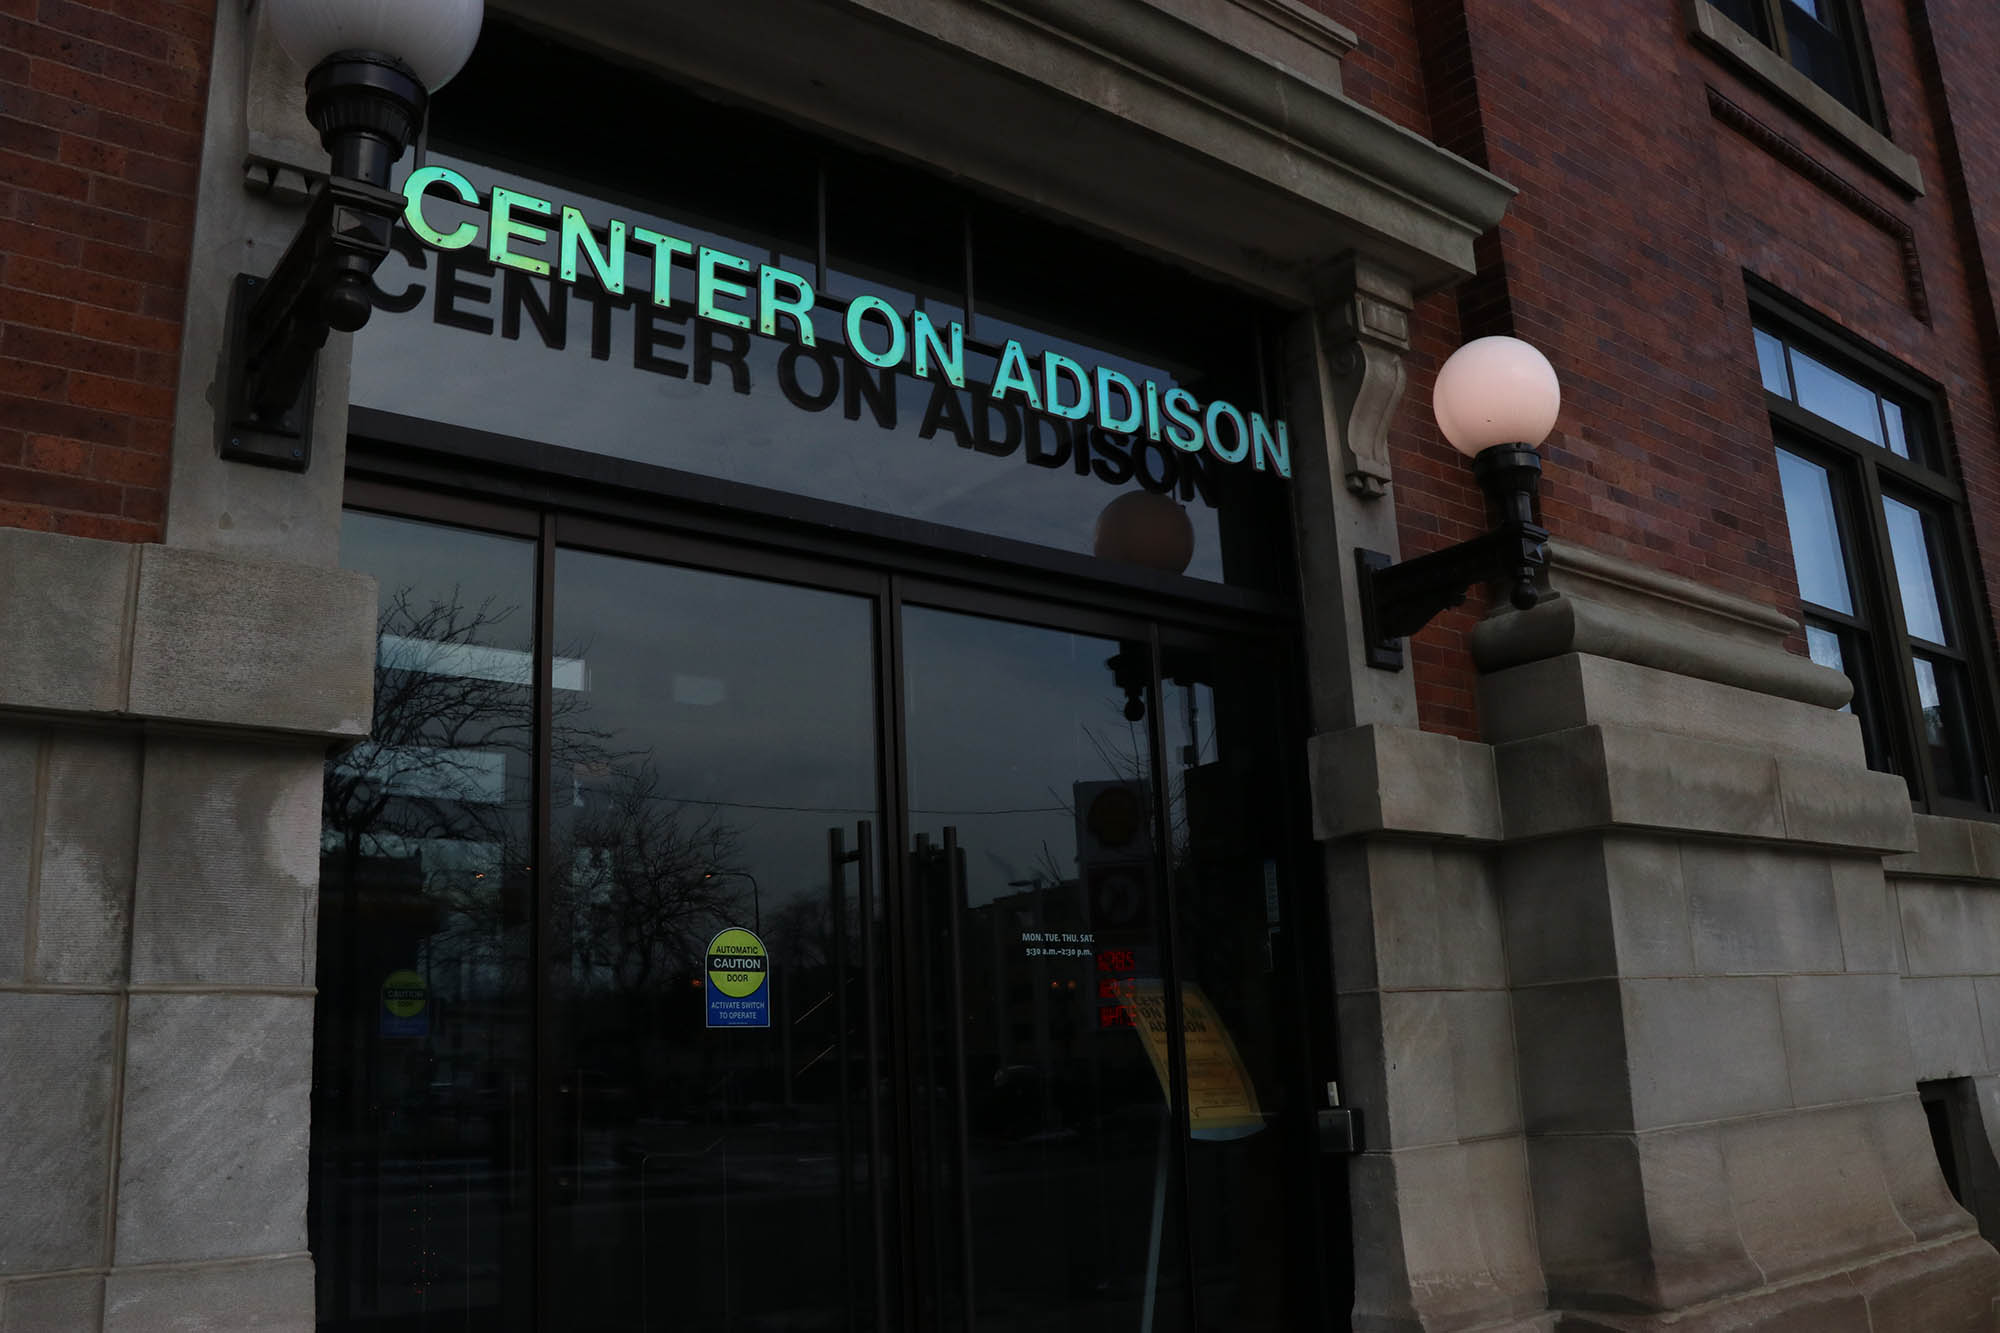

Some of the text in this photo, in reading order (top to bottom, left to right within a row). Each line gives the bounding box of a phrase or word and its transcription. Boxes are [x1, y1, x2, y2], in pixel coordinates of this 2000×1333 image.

[401, 165, 1293, 480] CENTER ON ADDISON
[370, 227, 751, 395] CENTER
[776, 343, 898, 430] ON
[1080, 934, 1095, 943] SAT.
[716, 946, 759, 954] AUTOMATIC
[713, 958, 761, 969] CAUTION
[726, 974, 749, 982] DOOR
[711, 1001, 765, 1009] ACTIVATE SWITCH
[719, 1011, 728, 1019] TO
